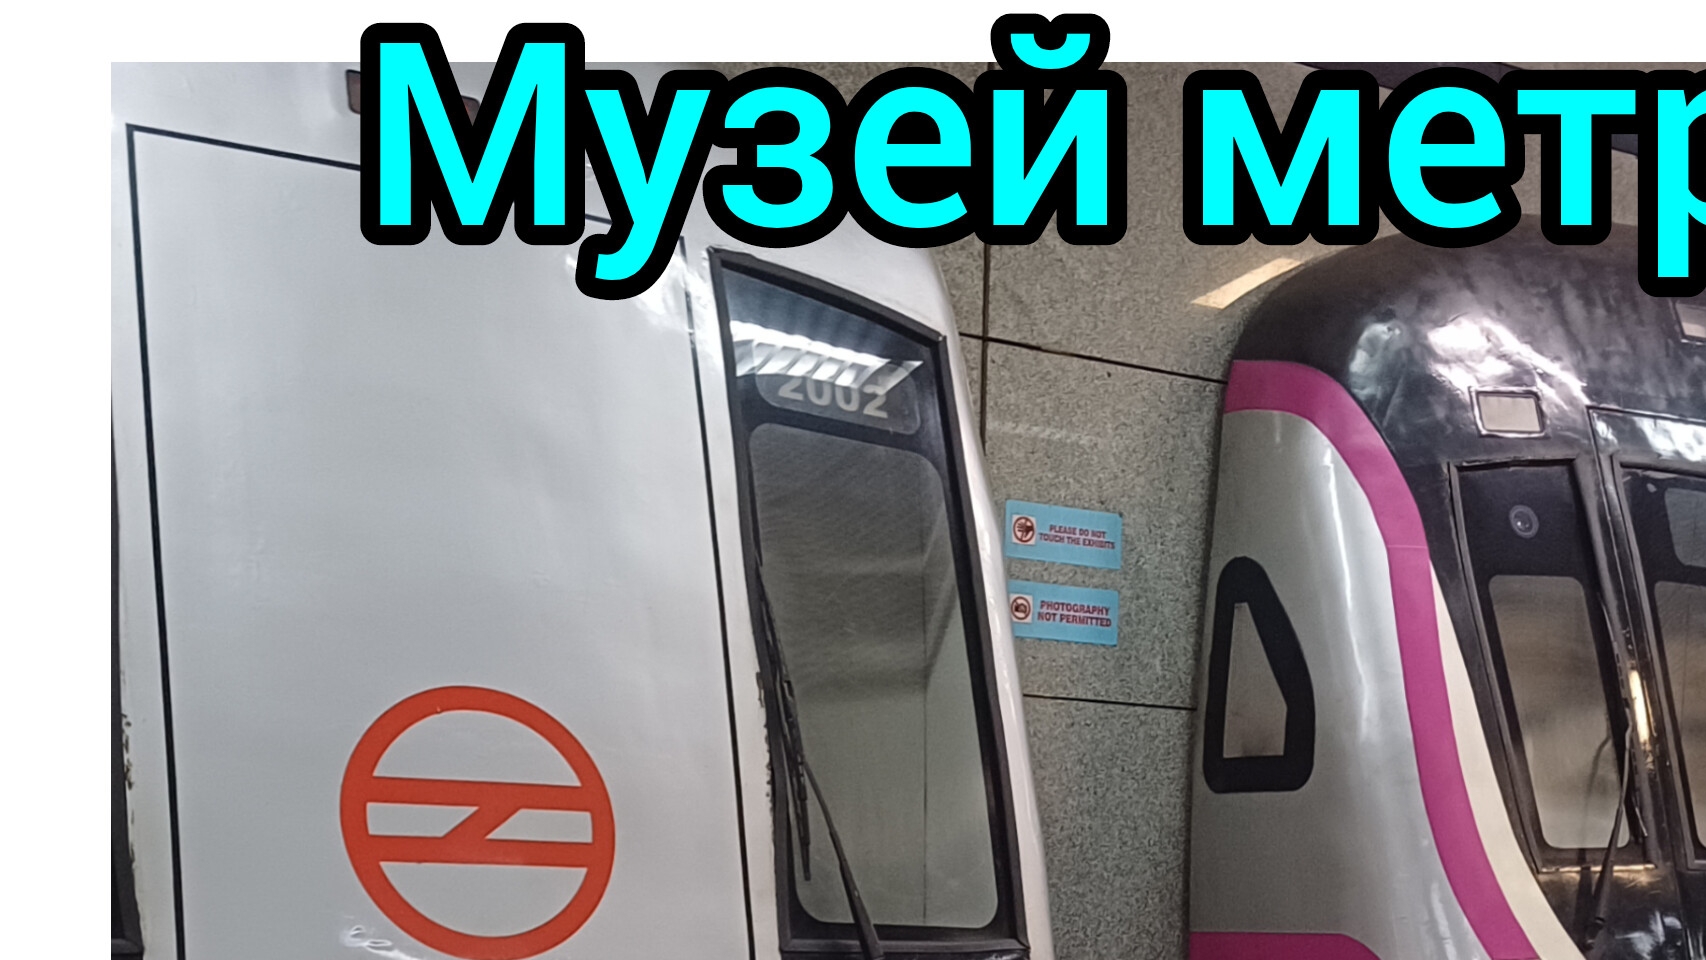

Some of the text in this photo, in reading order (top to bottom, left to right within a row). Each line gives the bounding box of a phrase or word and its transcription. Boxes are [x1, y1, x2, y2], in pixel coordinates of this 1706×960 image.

[777, 368, 890, 419] 2002
[1049, 524, 1107, 539] PLEASE DO NOT
[1039, 532, 1115, 550] TOUCH THE EXHIBITS
[1040, 600, 1110, 616] PHOTOGRAPHY
[1038, 611, 1112, 628] NOT PERMITTED
